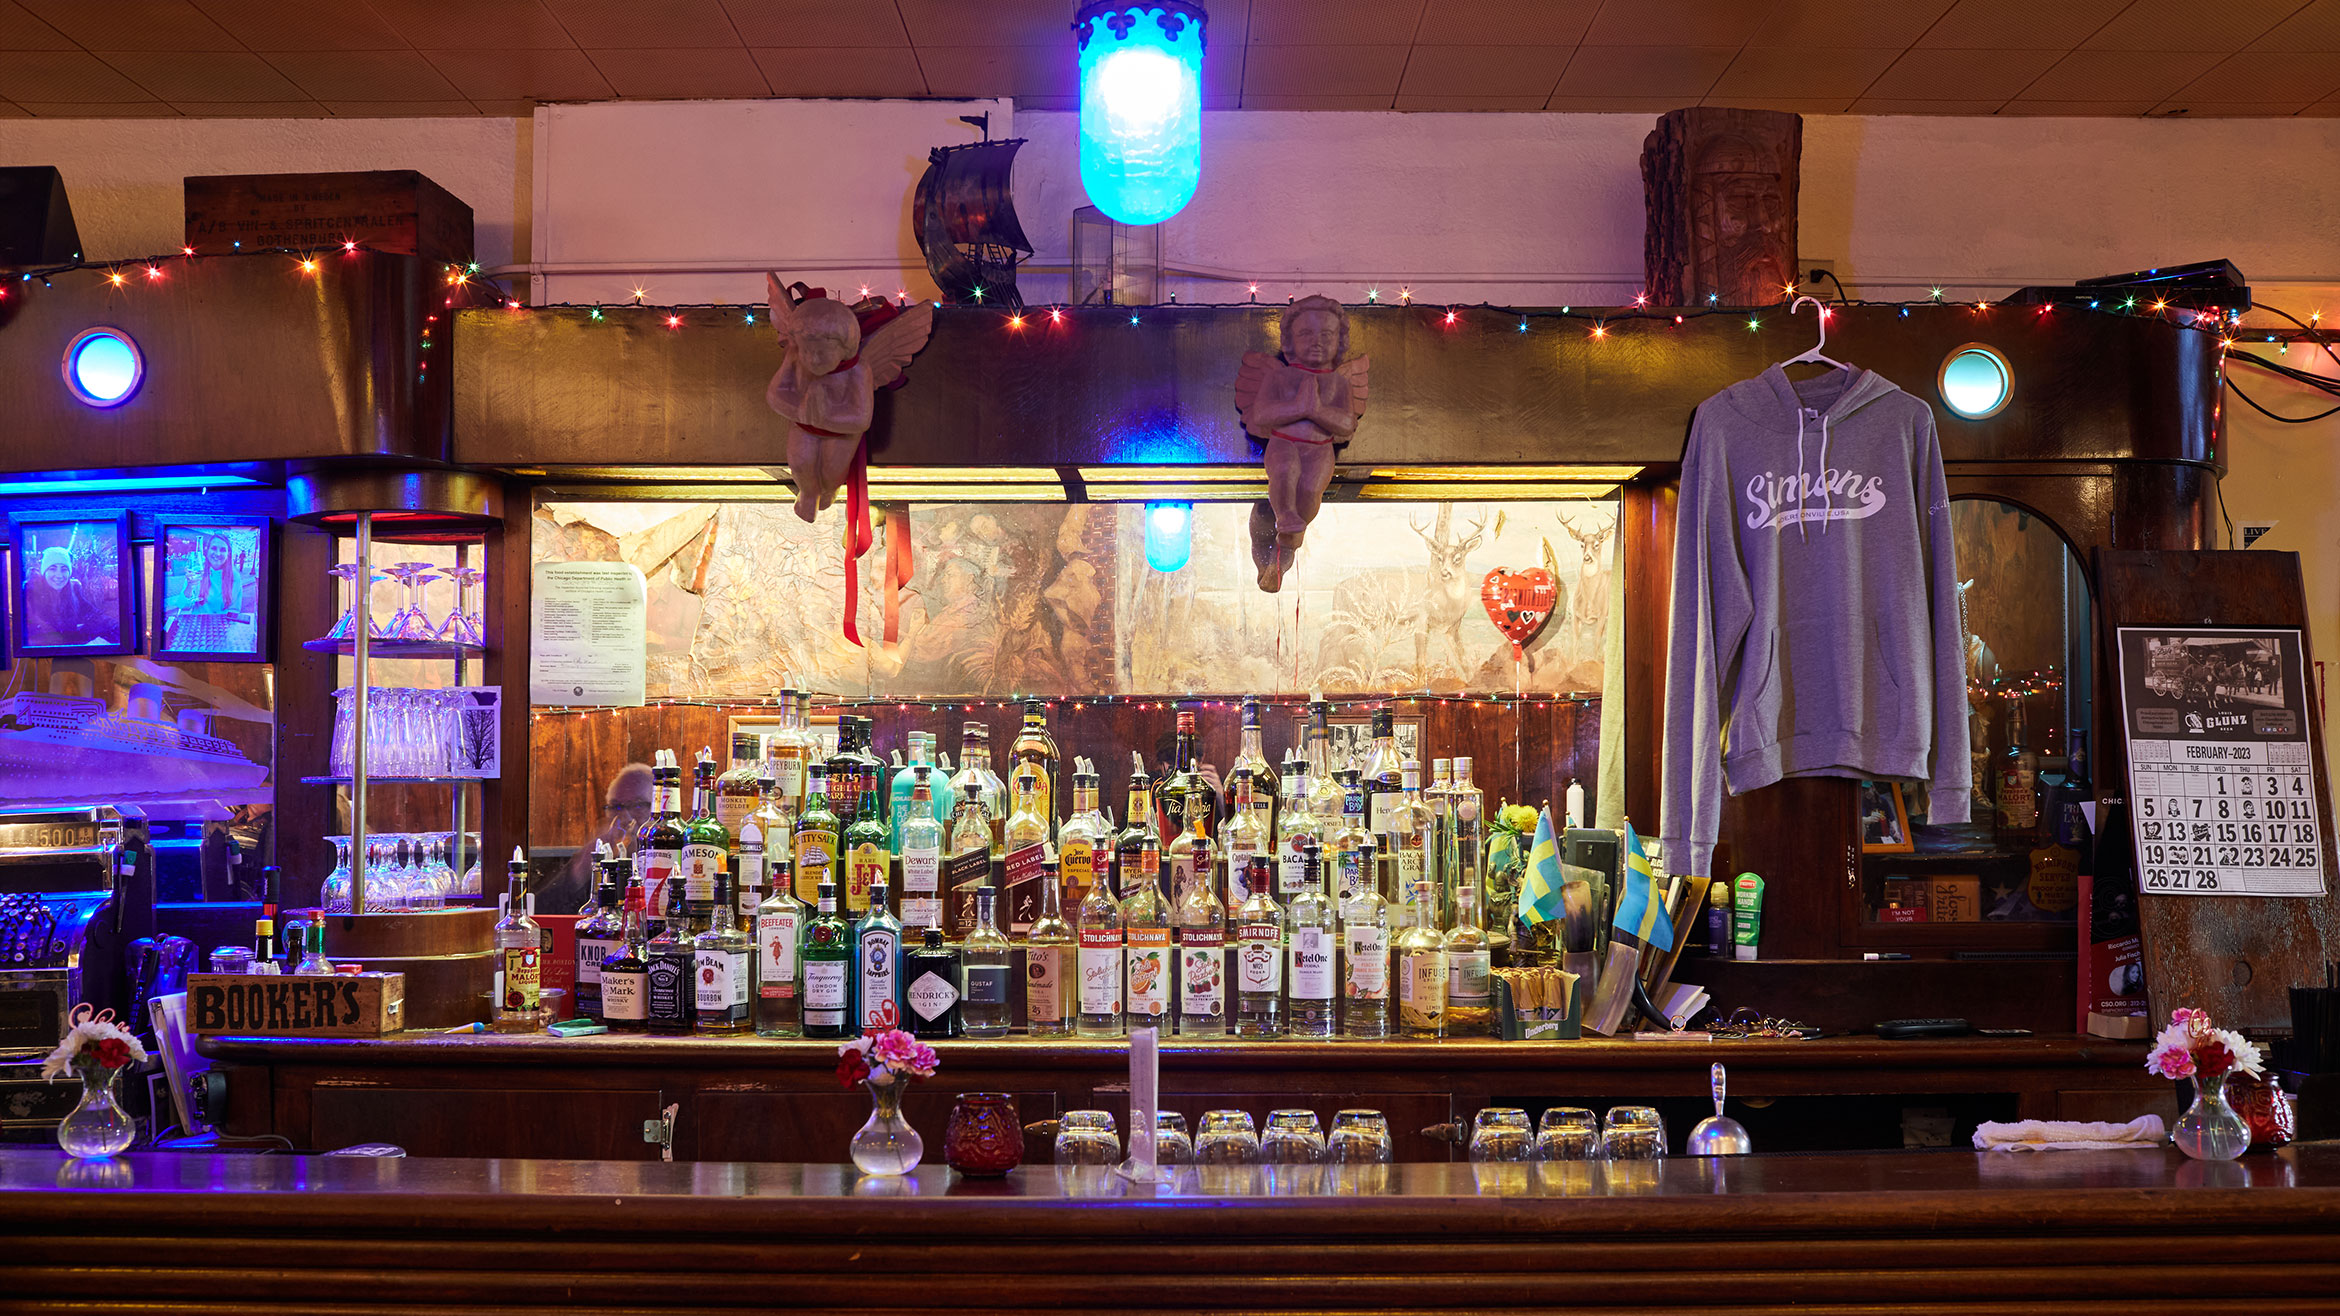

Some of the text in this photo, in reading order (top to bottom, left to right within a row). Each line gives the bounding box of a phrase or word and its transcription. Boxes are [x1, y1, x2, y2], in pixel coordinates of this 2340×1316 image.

[1747, 468, 1886, 529] Simons
[2206, 715, 2248, 729] GLUNZ
[770, 760, 800, 771] SPEYBURN
[2217, 776, 2227, 795] 1
[2267, 776, 2279, 795] 3
[2292, 777, 2304, 796] 4
[663, 795, 670, 809] 7
[2143, 798, 2155, 817] 5
[2192, 799, 2203, 818] 7
[2218, 799, 2230, 818] 8
[2265, 800, 2286, 819] 10
[2291, 800, 2311, 820] 11
[2142, 821, 2163, 840] 12
[2167, 822, 2187, 841] 13
[2216, 823, 2237, 842] 15
[2242, 823, 2262, 843] 16
[2267, 824, 2287, 843] 17
[2293, 824, 2315, 843] 18
[796, 833, 836, 847] CUTTY SARK
[647, 851, 672, 860] eagram's
[905, 855, 936, 865] Dewar's
[1065, 854, 1091, 866] Cuervo
[2145, 845, 2164, 865] 19
[2193, 847, 2214, 865] 21
[2243, 847, 2265, 866] 23
[2269, 847, 2291, 867] 24
[2295, 848, 2317, 867] 25
[952, 859, 987, 875] BLACK LABEL
[1006, 854, 1045, 871] RED LABEL
[2147, 868, 2218, 889] 26 27 28
[646, 867, 672, 916] 7
[761, 918, 793, 929] BEEFEATER
[1182, 933, 1223, 942] STOLICHNAYA
[1239, 928, 1279, 938] SMIRNOFF
[867, 938, 889, 949] BOMBAY
[1354, 942, 1372, 955] Ketel
[2108, 940, 2131, 950] Riccardo
[581, 945, 607, 961] KNOB
[1028, 951, 1049, 961] Tito's
[1295, 951, 1328, 967] Ketel One
[648, 960, 680, 976] JACK DANIEL'S
[706, 956, 724, 972] BEAM
[808, 973, 843, 983] Tanqueray
[866, 968, 890, 978] SAPPHIRE
[1418, 968, 1446, 980] INFUSE
[602, 976, 635, 986] Maker's
[610, 987, 635, 995] Mark
[909, 991, 955, 1000] HENDRICK'S
[697, 994, 722, 1002] BOURBON
[196, 981, 361, 1030] BOOKER'S
[1525, 1022, 1558, 1039] Underberg
